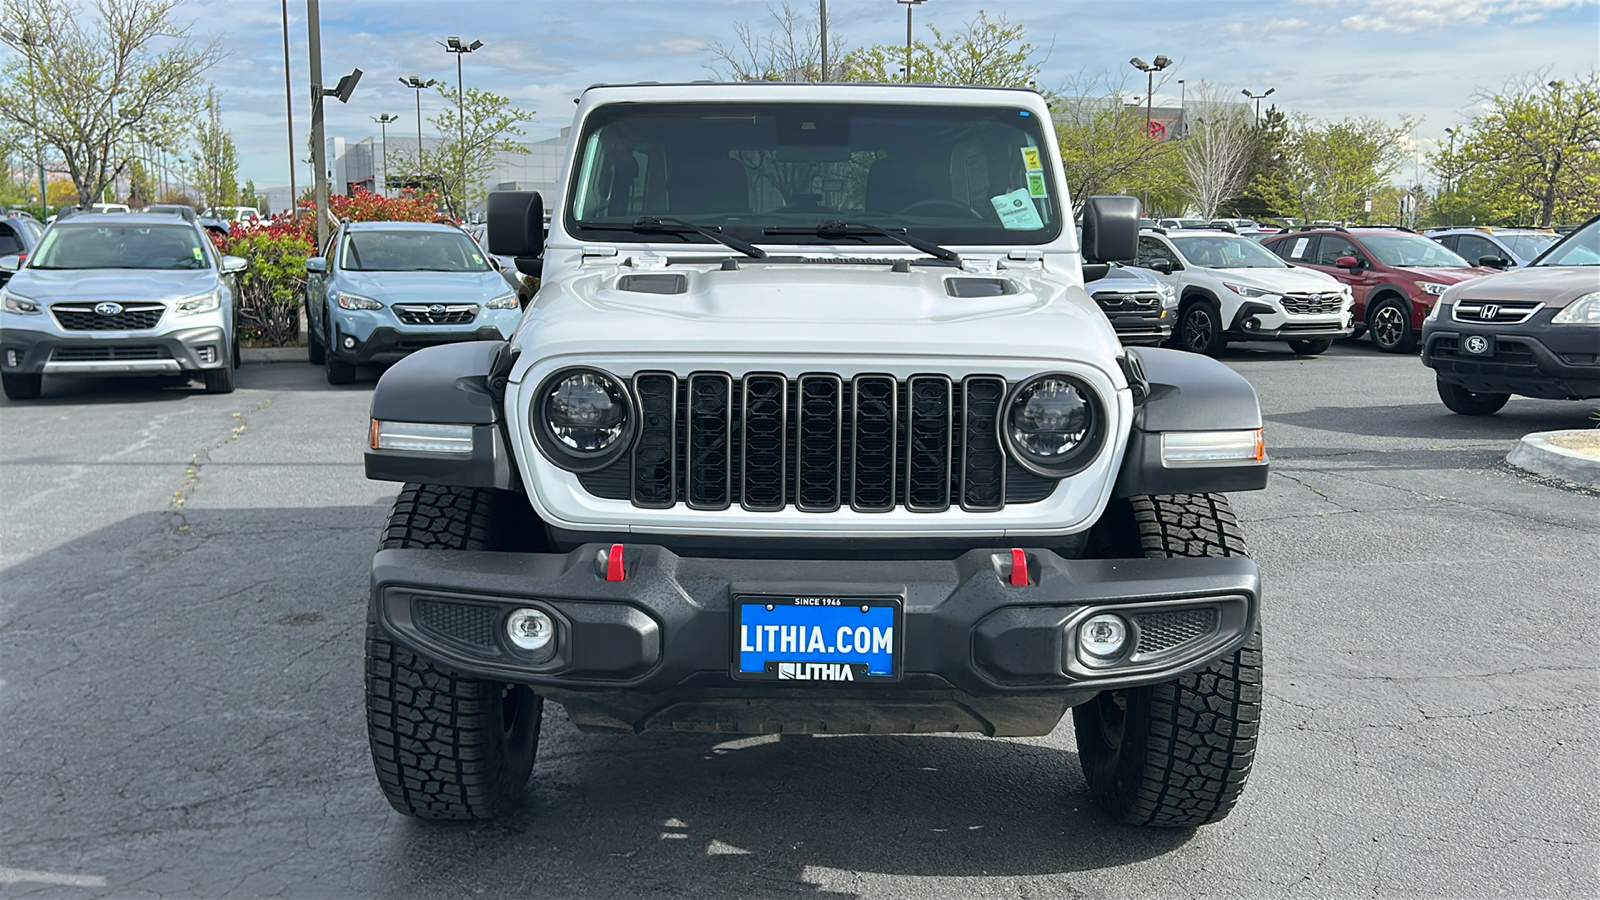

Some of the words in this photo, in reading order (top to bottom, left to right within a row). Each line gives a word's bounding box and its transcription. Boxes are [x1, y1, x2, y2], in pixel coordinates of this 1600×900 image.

[794, 597, 820, 606] SINCE
[822, 598, 841, 606] 1946
[741, 624, 893, 654] LITHIA.COM
[796, 663, 854, 681] LITHIA
